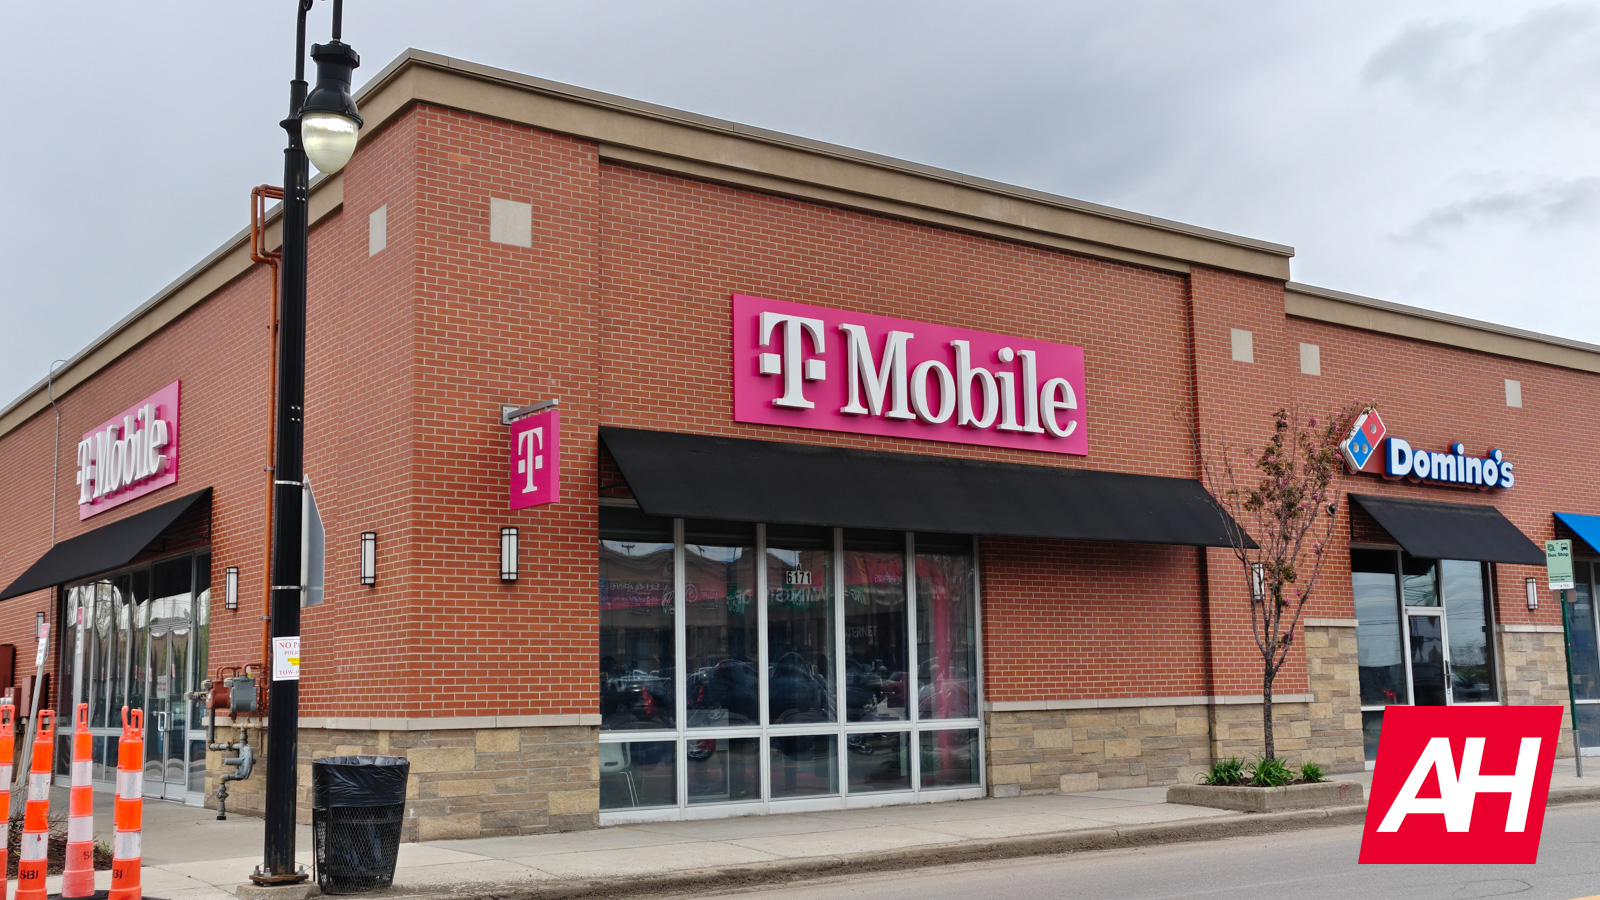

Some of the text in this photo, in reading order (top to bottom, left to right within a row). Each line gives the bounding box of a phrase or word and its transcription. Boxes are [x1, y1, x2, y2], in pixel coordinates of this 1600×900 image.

[518, 426, 543, 494] T
[1386, 437, 1515, 488] Domino's
[787, 571, 810, 584] 6171
[20, 870, 39, 880] SBI
[113, 869, 123, 880] BI
